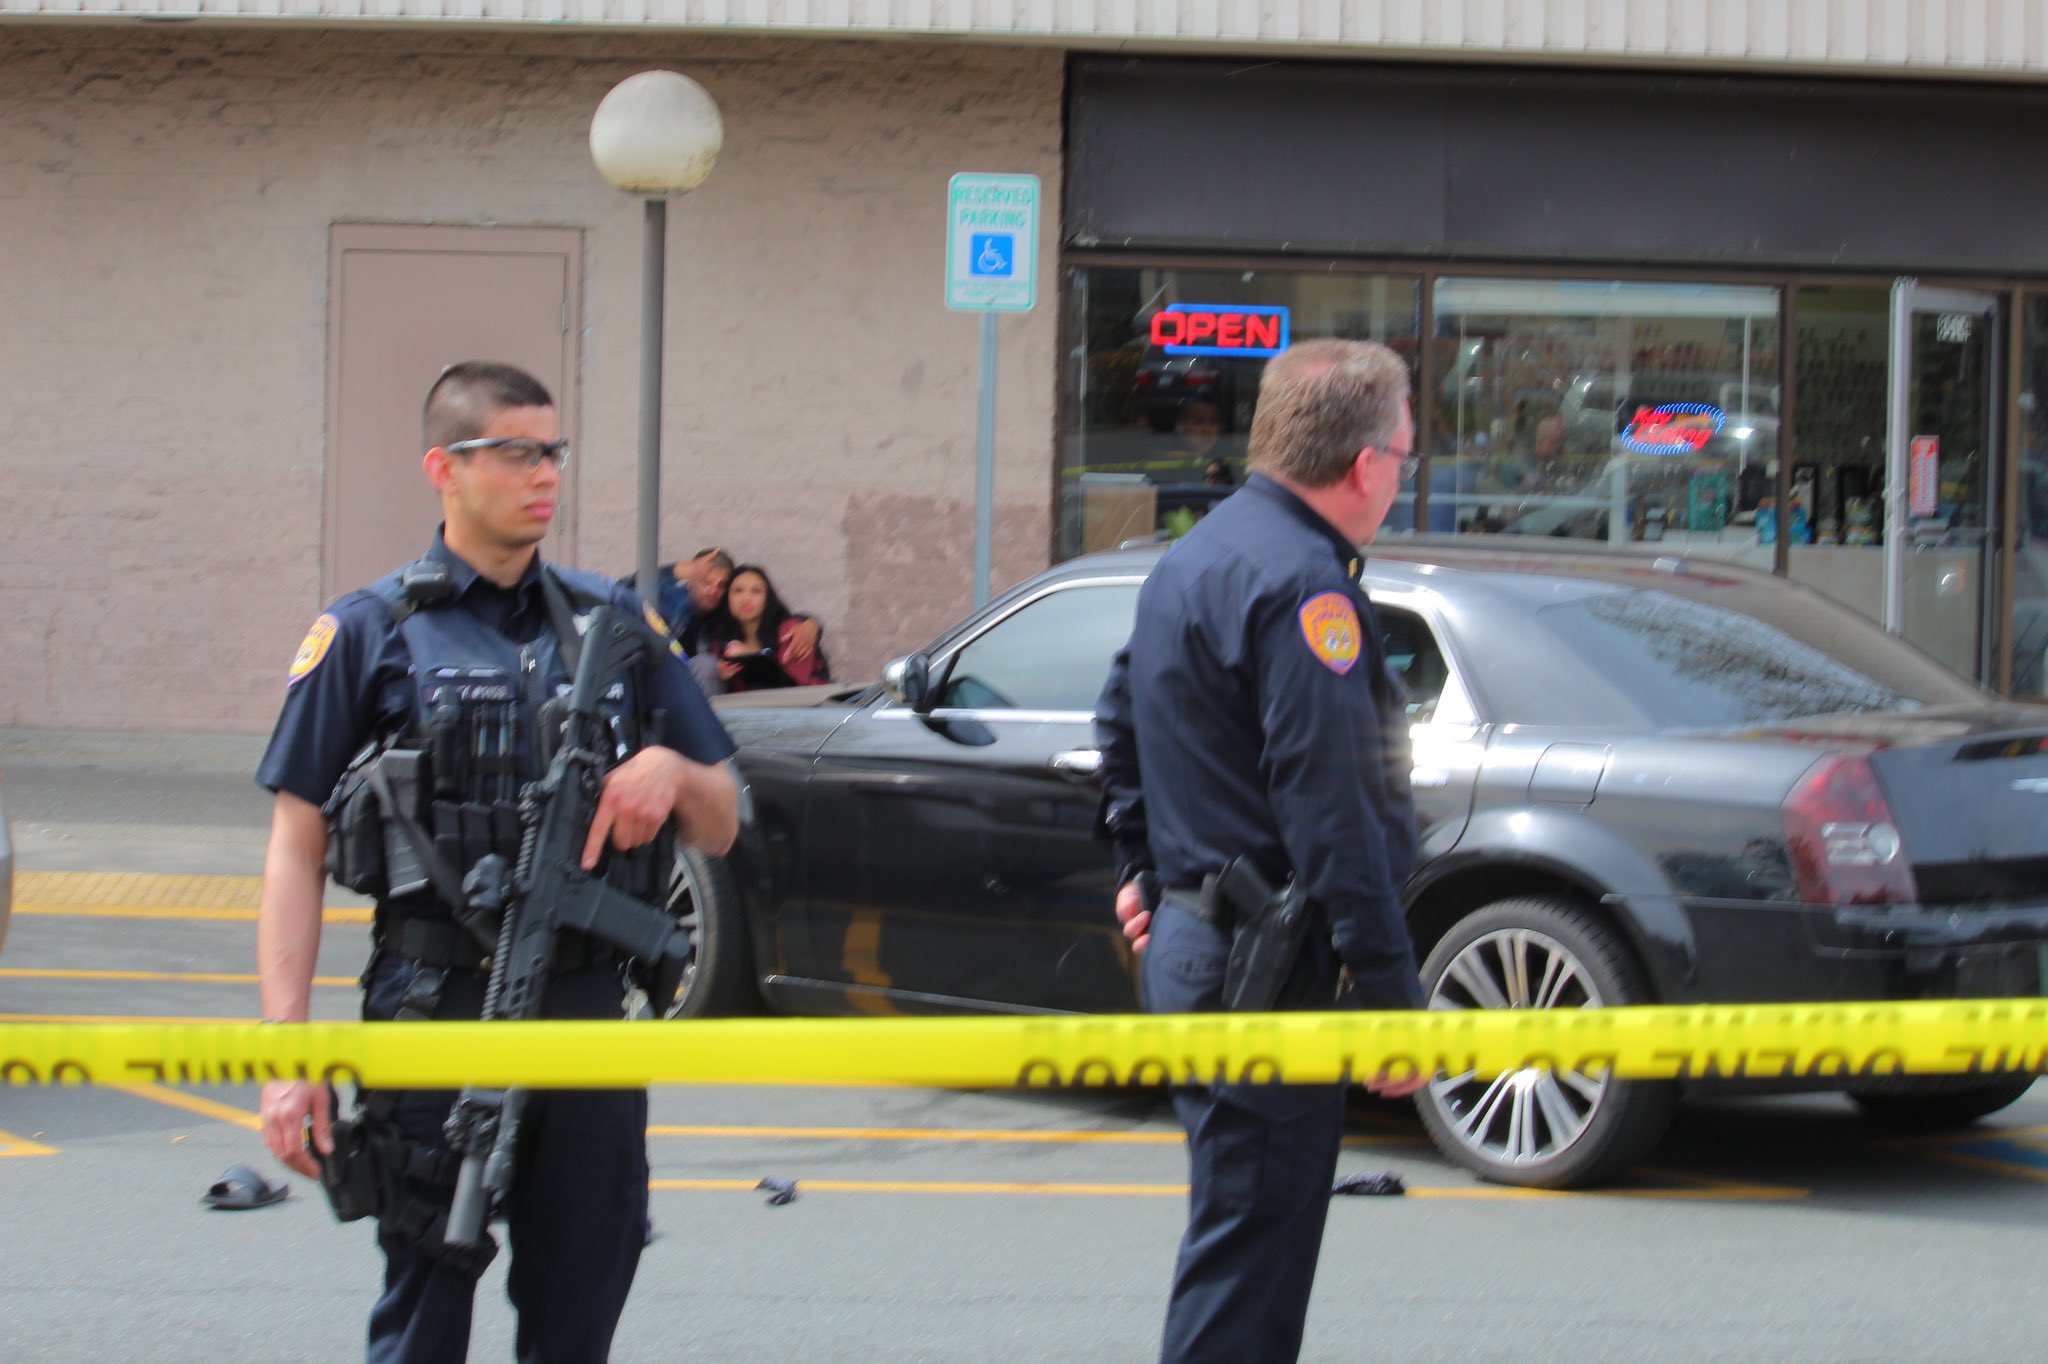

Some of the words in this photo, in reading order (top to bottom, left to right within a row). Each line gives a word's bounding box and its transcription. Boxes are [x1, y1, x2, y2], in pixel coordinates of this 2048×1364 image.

[954, 185, 1032, 205] RESERVED
[959, 209, 1027, 228] PARKING
[1151, 311, 1280, 348] OPEN
